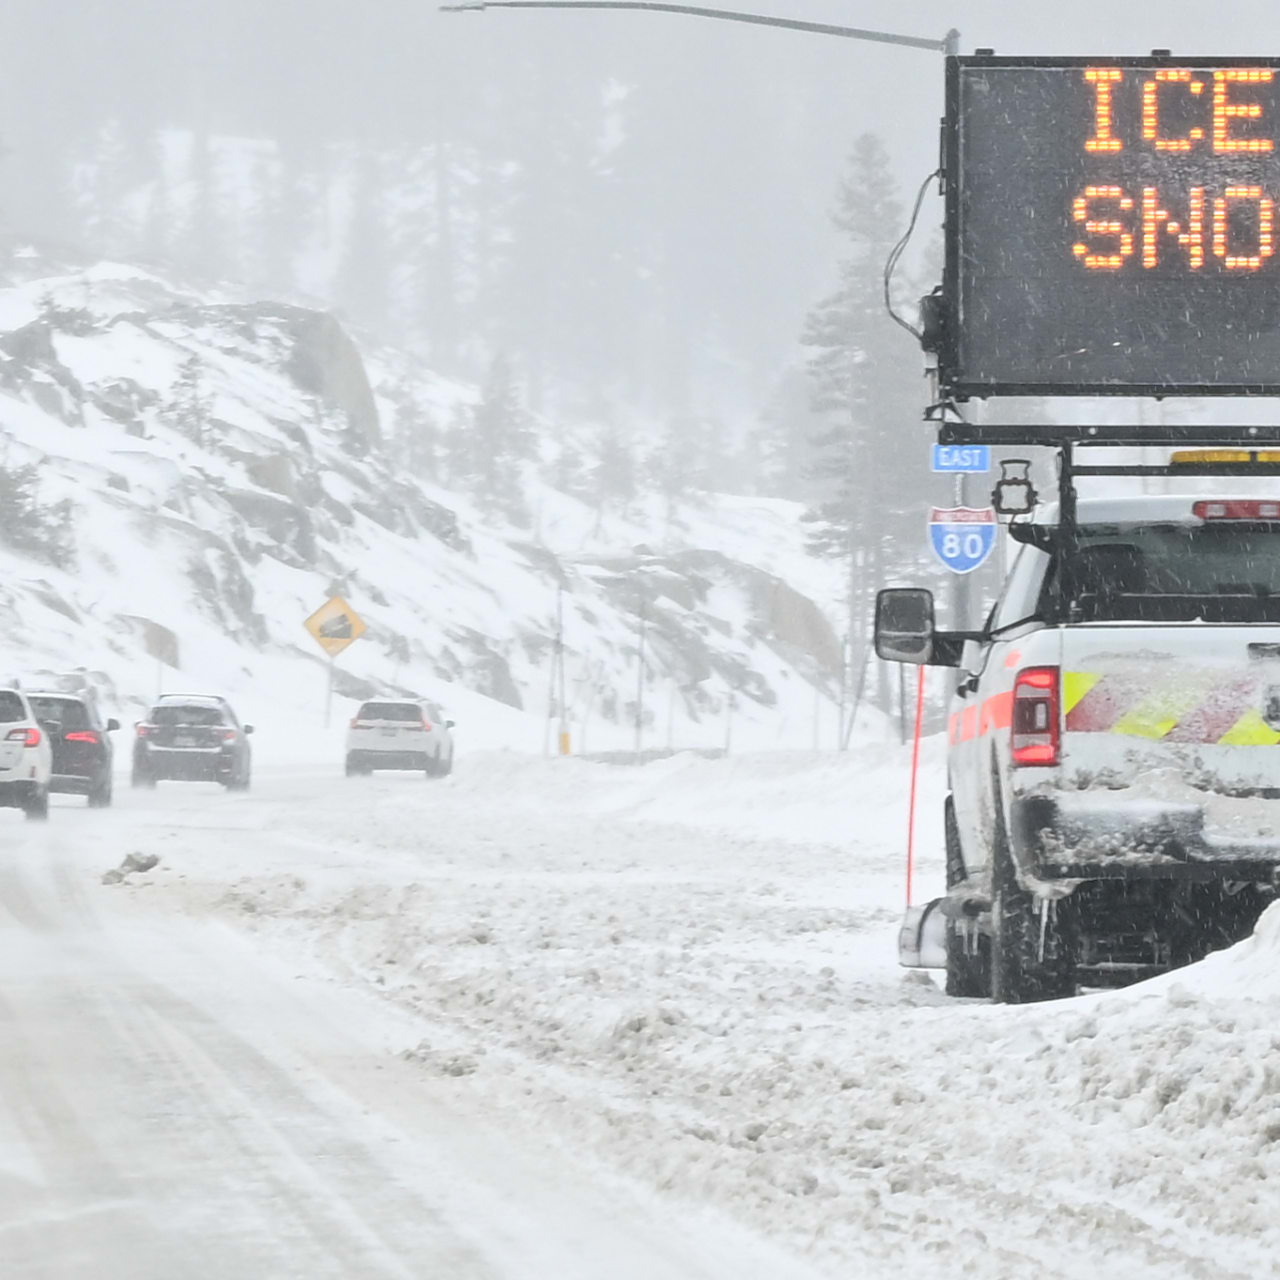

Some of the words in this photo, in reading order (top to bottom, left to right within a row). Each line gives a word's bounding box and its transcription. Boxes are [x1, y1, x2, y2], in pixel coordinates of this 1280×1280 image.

[1083, 68, 1274, 152] ICE
[1072, 186, 1274, 269] SNO
[939, 447, 982, 467] EAST
[942, 533, 983, 559] 80
